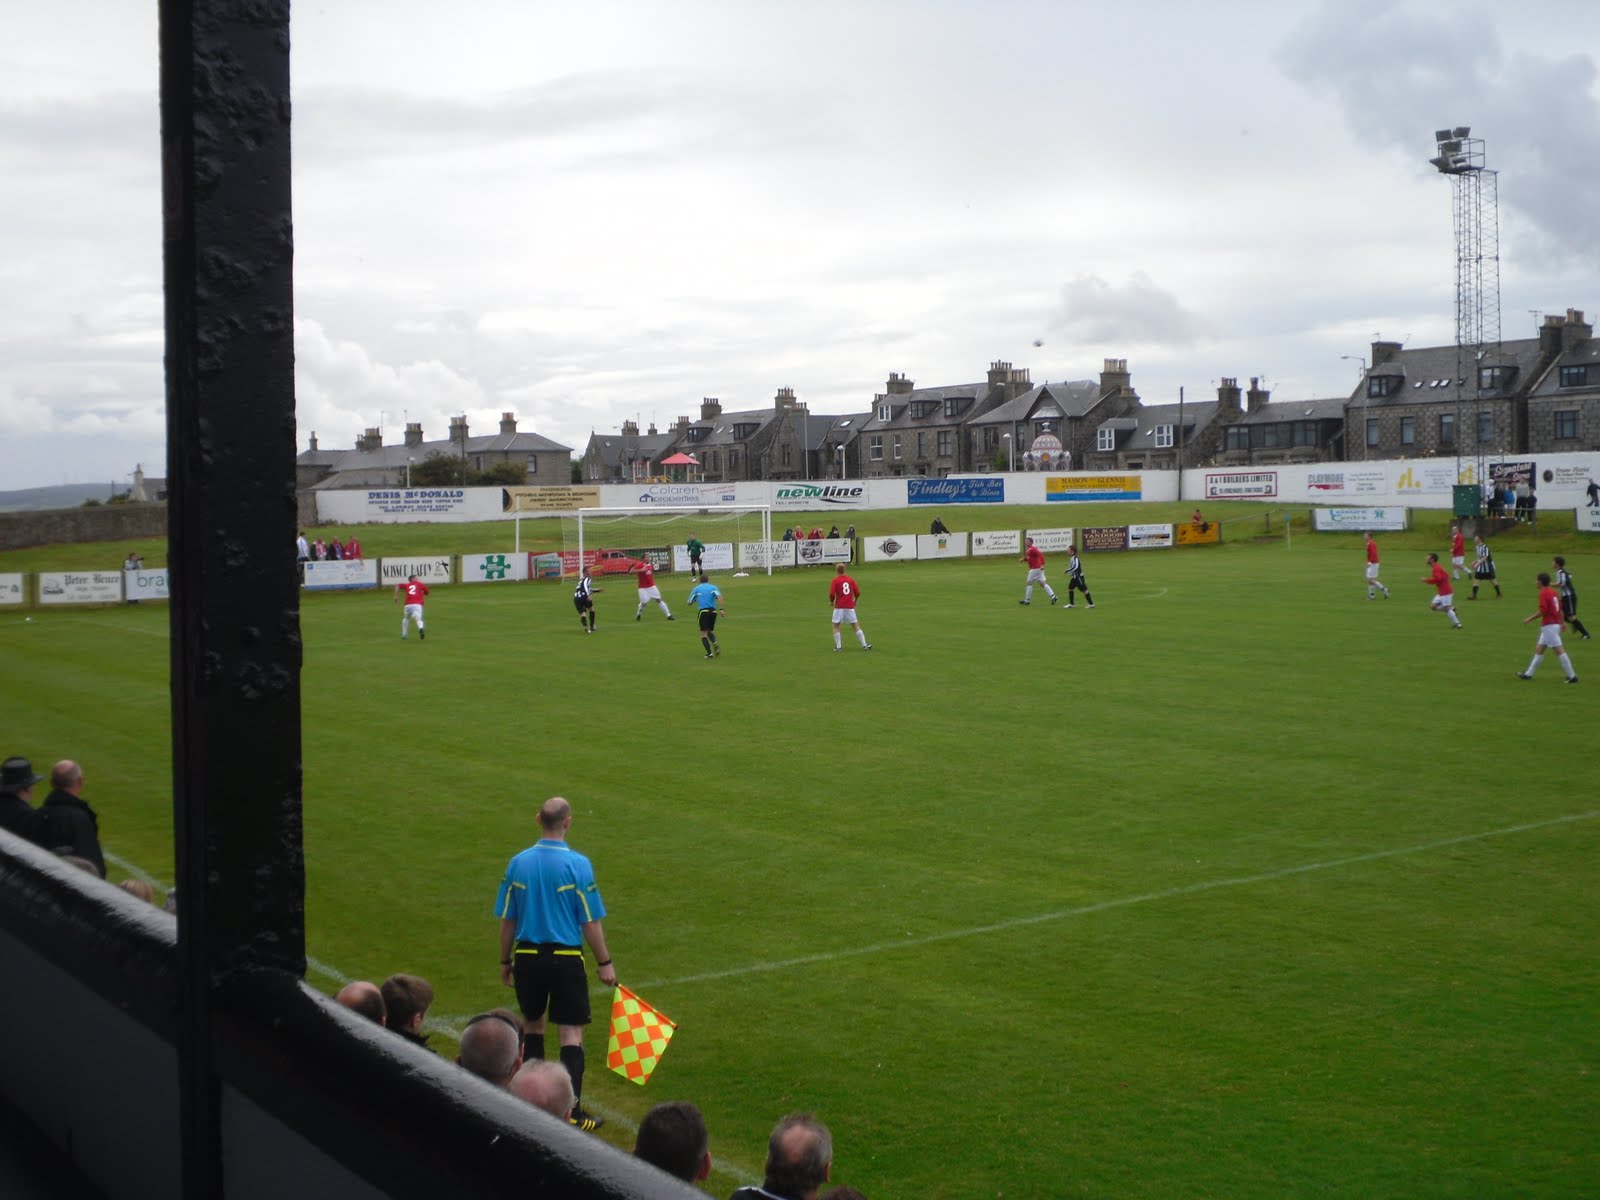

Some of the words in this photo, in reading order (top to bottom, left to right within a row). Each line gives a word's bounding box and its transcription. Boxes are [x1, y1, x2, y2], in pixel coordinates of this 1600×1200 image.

[1494, 463, 1533, 478] Signature
[1308, 473, 1344, 483] CLAYMORE
[649, 486, 699, 494] Colaren
[776, 486, 863, 497] newline
[908, 480, 967, 498] Findlay's
[968, 480, 984, 488] Fish
[986, 480, 1001, 488] Bar
[368, 492, 400, 500] DENIS
[654, 496, 699, 504] properties
[64, 574, 88, 586] Peter
[136, 572, 168, 588] bra
[408, 584, 416, 595] 2
[842, 582, 850, 596] 8
